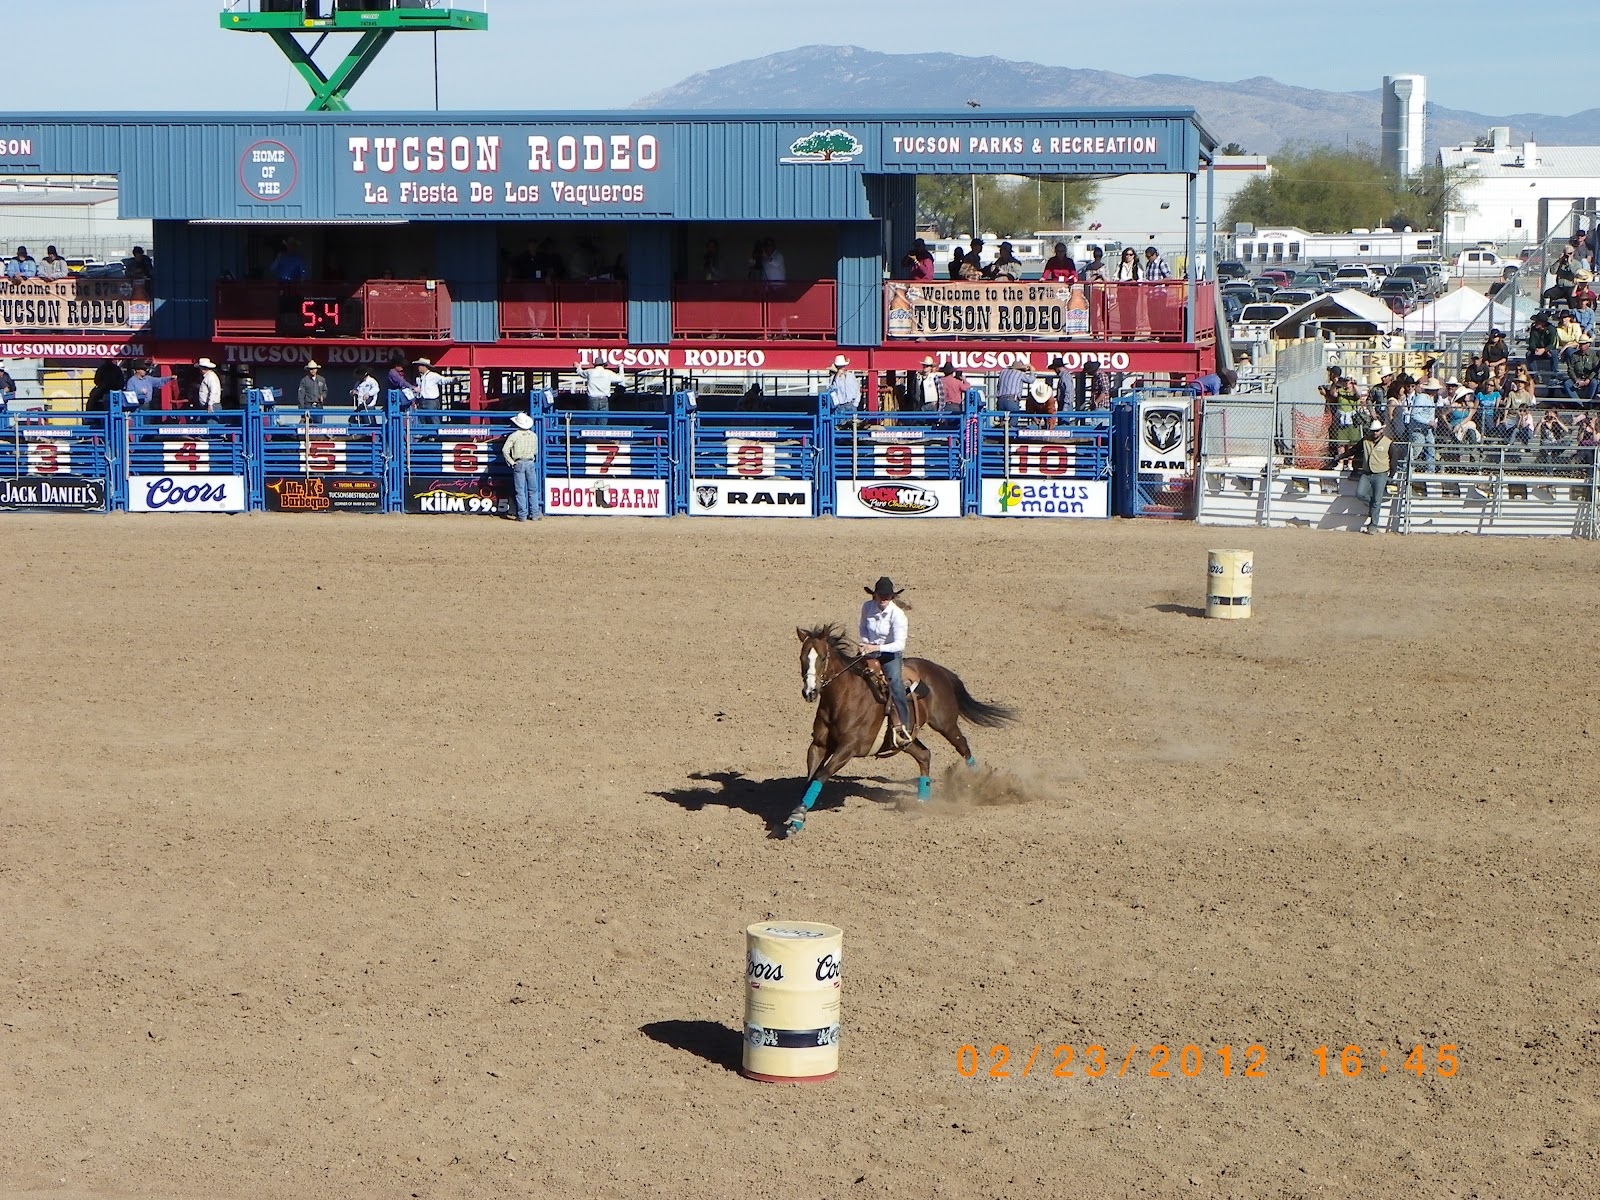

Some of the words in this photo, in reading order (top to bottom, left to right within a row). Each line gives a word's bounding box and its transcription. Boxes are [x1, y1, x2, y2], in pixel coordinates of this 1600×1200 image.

[348, 136, 502, 174] TUCSON
[528, 134, 658, 173] RODEO
[893, 136, 961, 154] TUCSON
[969, 136, 1024, 154] PARKS
[1032, 137, 1043, 154] &
[1050, 136, 1157, 154] RECREATION
[252, 150, 285, 163] HOME
[261, 166, 276, 179] OF
[258, 181, 280, 195] THE
[364, 182, 388, 204] La
[400, 182, 458, 204] Fiesta
[470, 181, 494, 203] De
[505, 181, 540, 204] Los
[550, 181, 645, 206] Vaqueros
[0, 281, 50, 296] Welcome
[56, 283, 66, 296] to
[922, 286, 980, 301] Welcome
[986, 288, 997, 301] to
[1003, 287, 1023, 300] the
[1029, 287, 1054, 301] 87th
[0, 300, 61, 325] UCSON
[67, 300, 126, 326] RODEO
[302, 301, 339, 327] 5.4
[914, 305, 992, 332] TUCSON
[998, 305, 1063, 332] RODEO
[225, 344, 313, 362] TUCSON
[684, 350, 765, 367] RODEO
[35, 444, 59, 472] 3
[175, 442, 200, 470] 4
[309, 442, 336, 471] 5
[454, 443, 478, 472] 6
[597, 445, 620, 474] 7
[738, 446, 763, 475] 8
[885, 446, 912, 476] 9
[1010, 444, 1068, 474] 10
[1140, 460, 1185, 470] RAM
[1, 482, 38, 503] JACK
[147, 478, 226, 509] Coors
[286, 482, 304, 496] Mr.
[550, 488, 596, 508] BOOT
[609, 488, 660, 508] BARN
[727, 492, 806, 505] RAM
[861, 487, 898, 502] ROCK
[1012, 482, 1088, 500] cactus
[281, 494, 330, 510] Barbeque
[468, 498, 510, 512] 99.5
[1021, 500, 1084, 513] moon
[746, 957, 784, 981] oors
